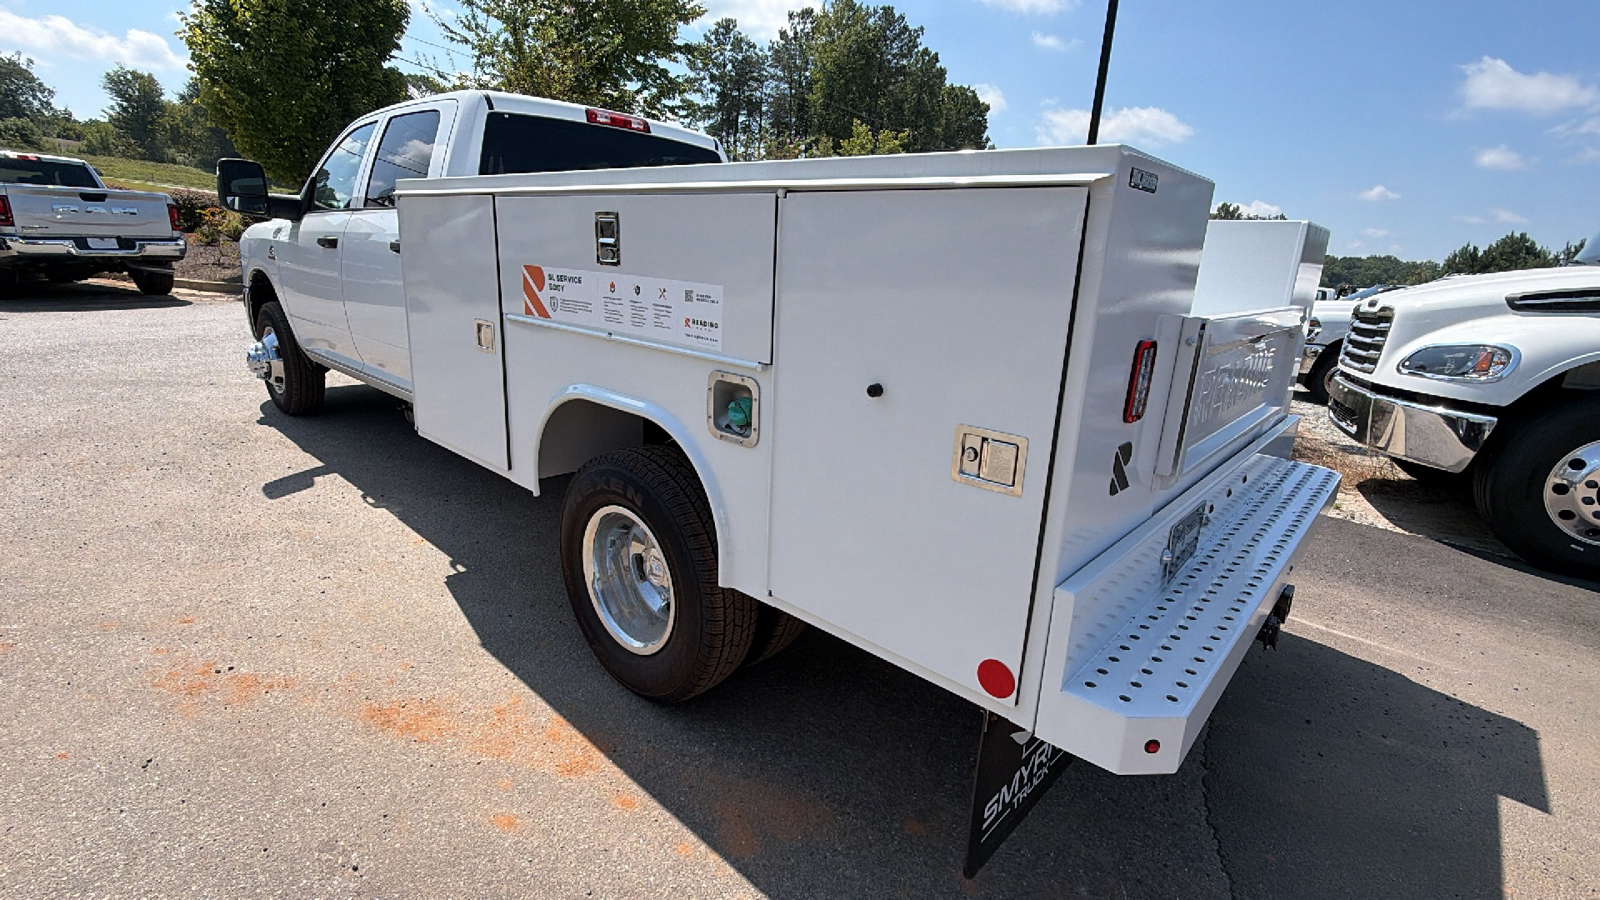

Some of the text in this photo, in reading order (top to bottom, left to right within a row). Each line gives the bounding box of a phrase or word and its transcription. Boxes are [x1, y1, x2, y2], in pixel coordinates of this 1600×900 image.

[52, 204, 138, 216] RAM
[548, 273, 582, 285] SL SERVICE
[691, 318, 719, 329] READING
[1012, 761, 1050, 809] TRUCK
